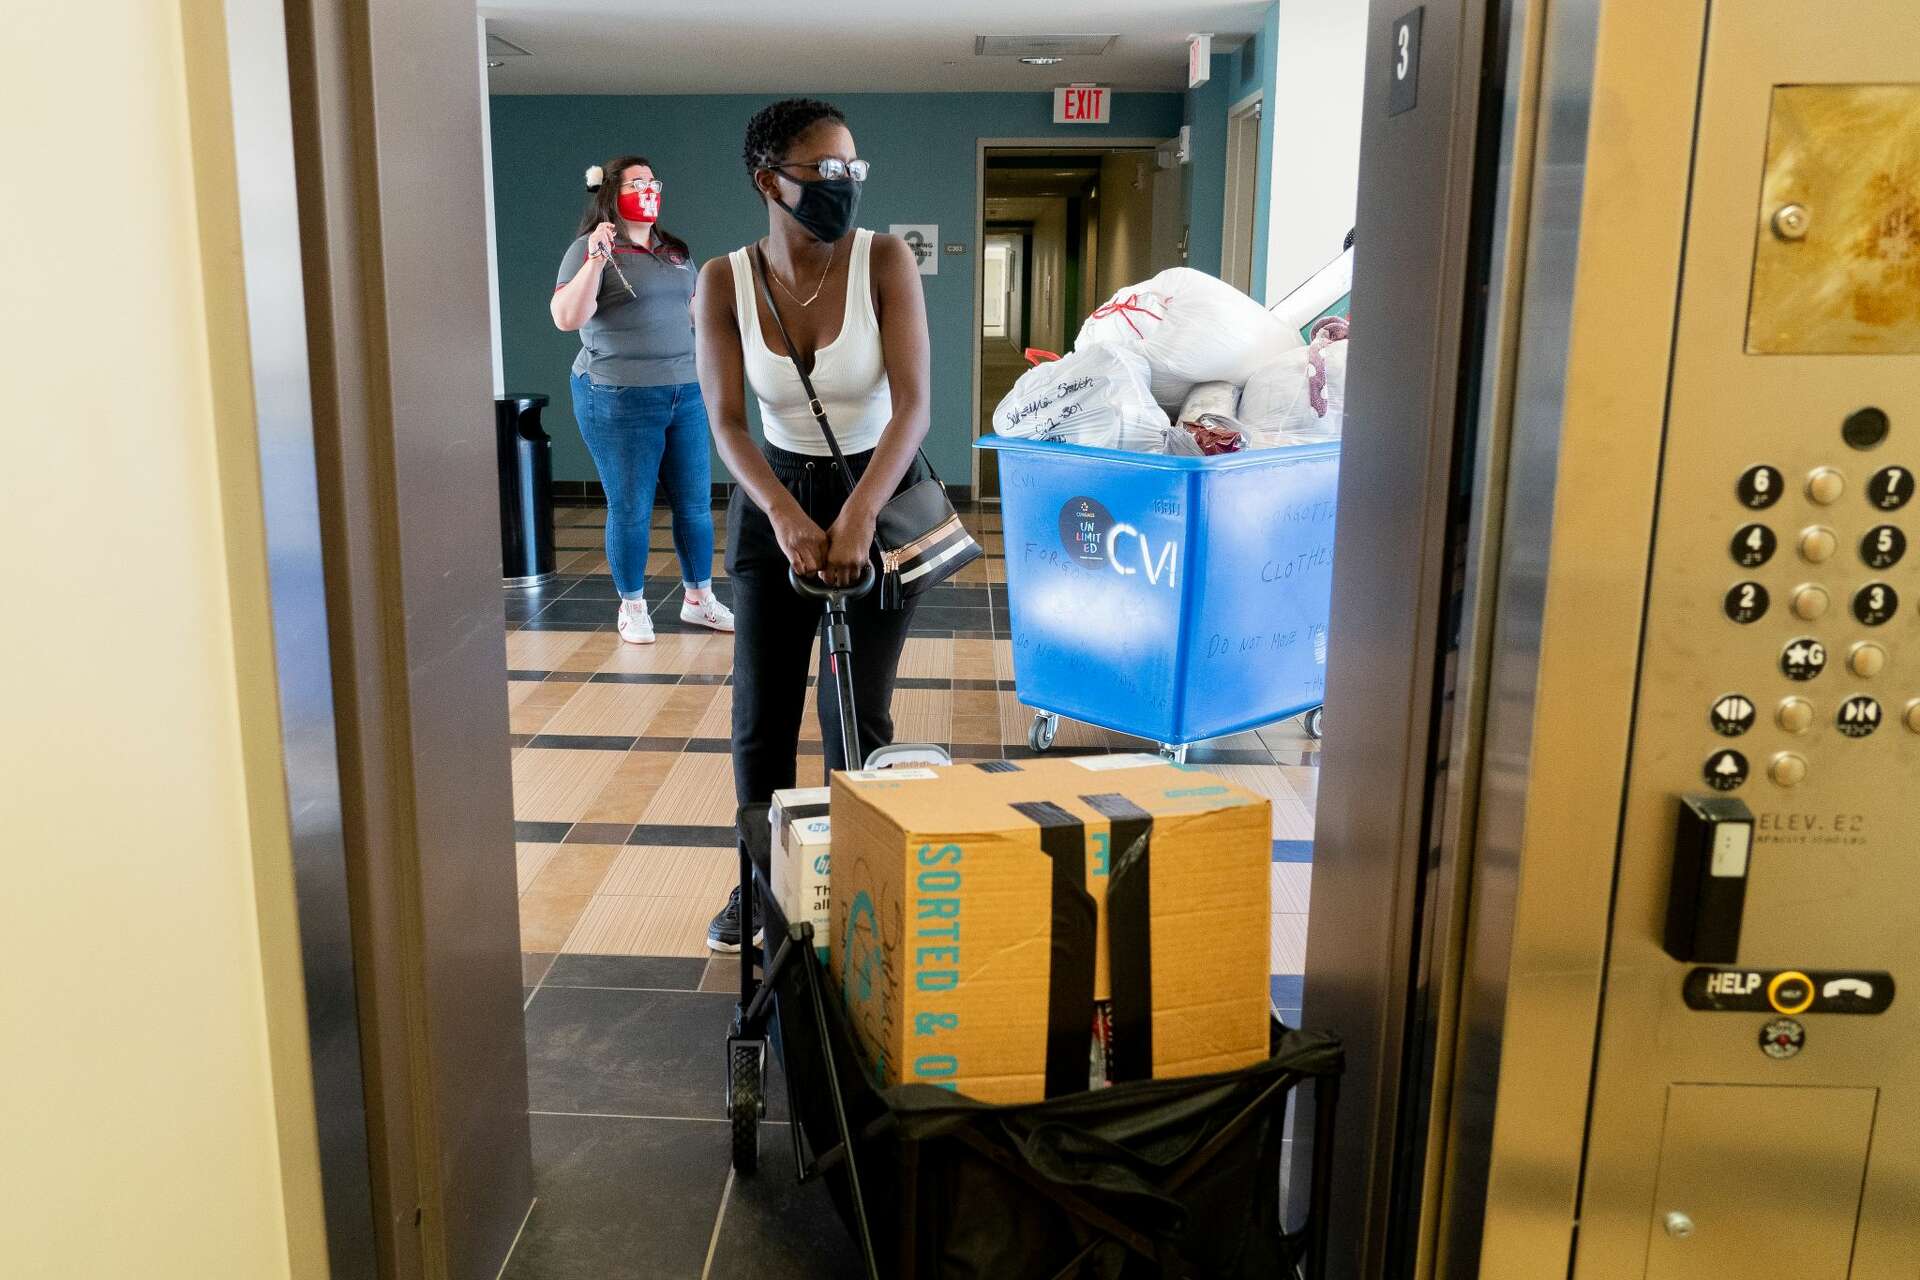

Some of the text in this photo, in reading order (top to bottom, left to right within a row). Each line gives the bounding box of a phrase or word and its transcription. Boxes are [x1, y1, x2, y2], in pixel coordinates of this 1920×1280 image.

[1397, 24, 1409, 81] 3
[1064, 89, 1103, 120] EXIT
[1754, 468, 1769, 493] 6
[1887, 469, 1902, 493] 7
[1076, 532, 1102, 543] LIMIT
[1080, 521, 1095, 532] UN
[1083, 543, 1098, 554] ED
[1746, 527, 1762, 550] 4
[1877, 529, 1892, 552] 5
[1740, 585, 1755, 608] 2
[1869, 587, 1884, 610] 3
[1760, 813, 1864, 832] ELEV. E2
[915, 843, 962, 993] SORTED
[1707, 972, 1762, 995] HELP
[914, 1012, 960, 1038] &
